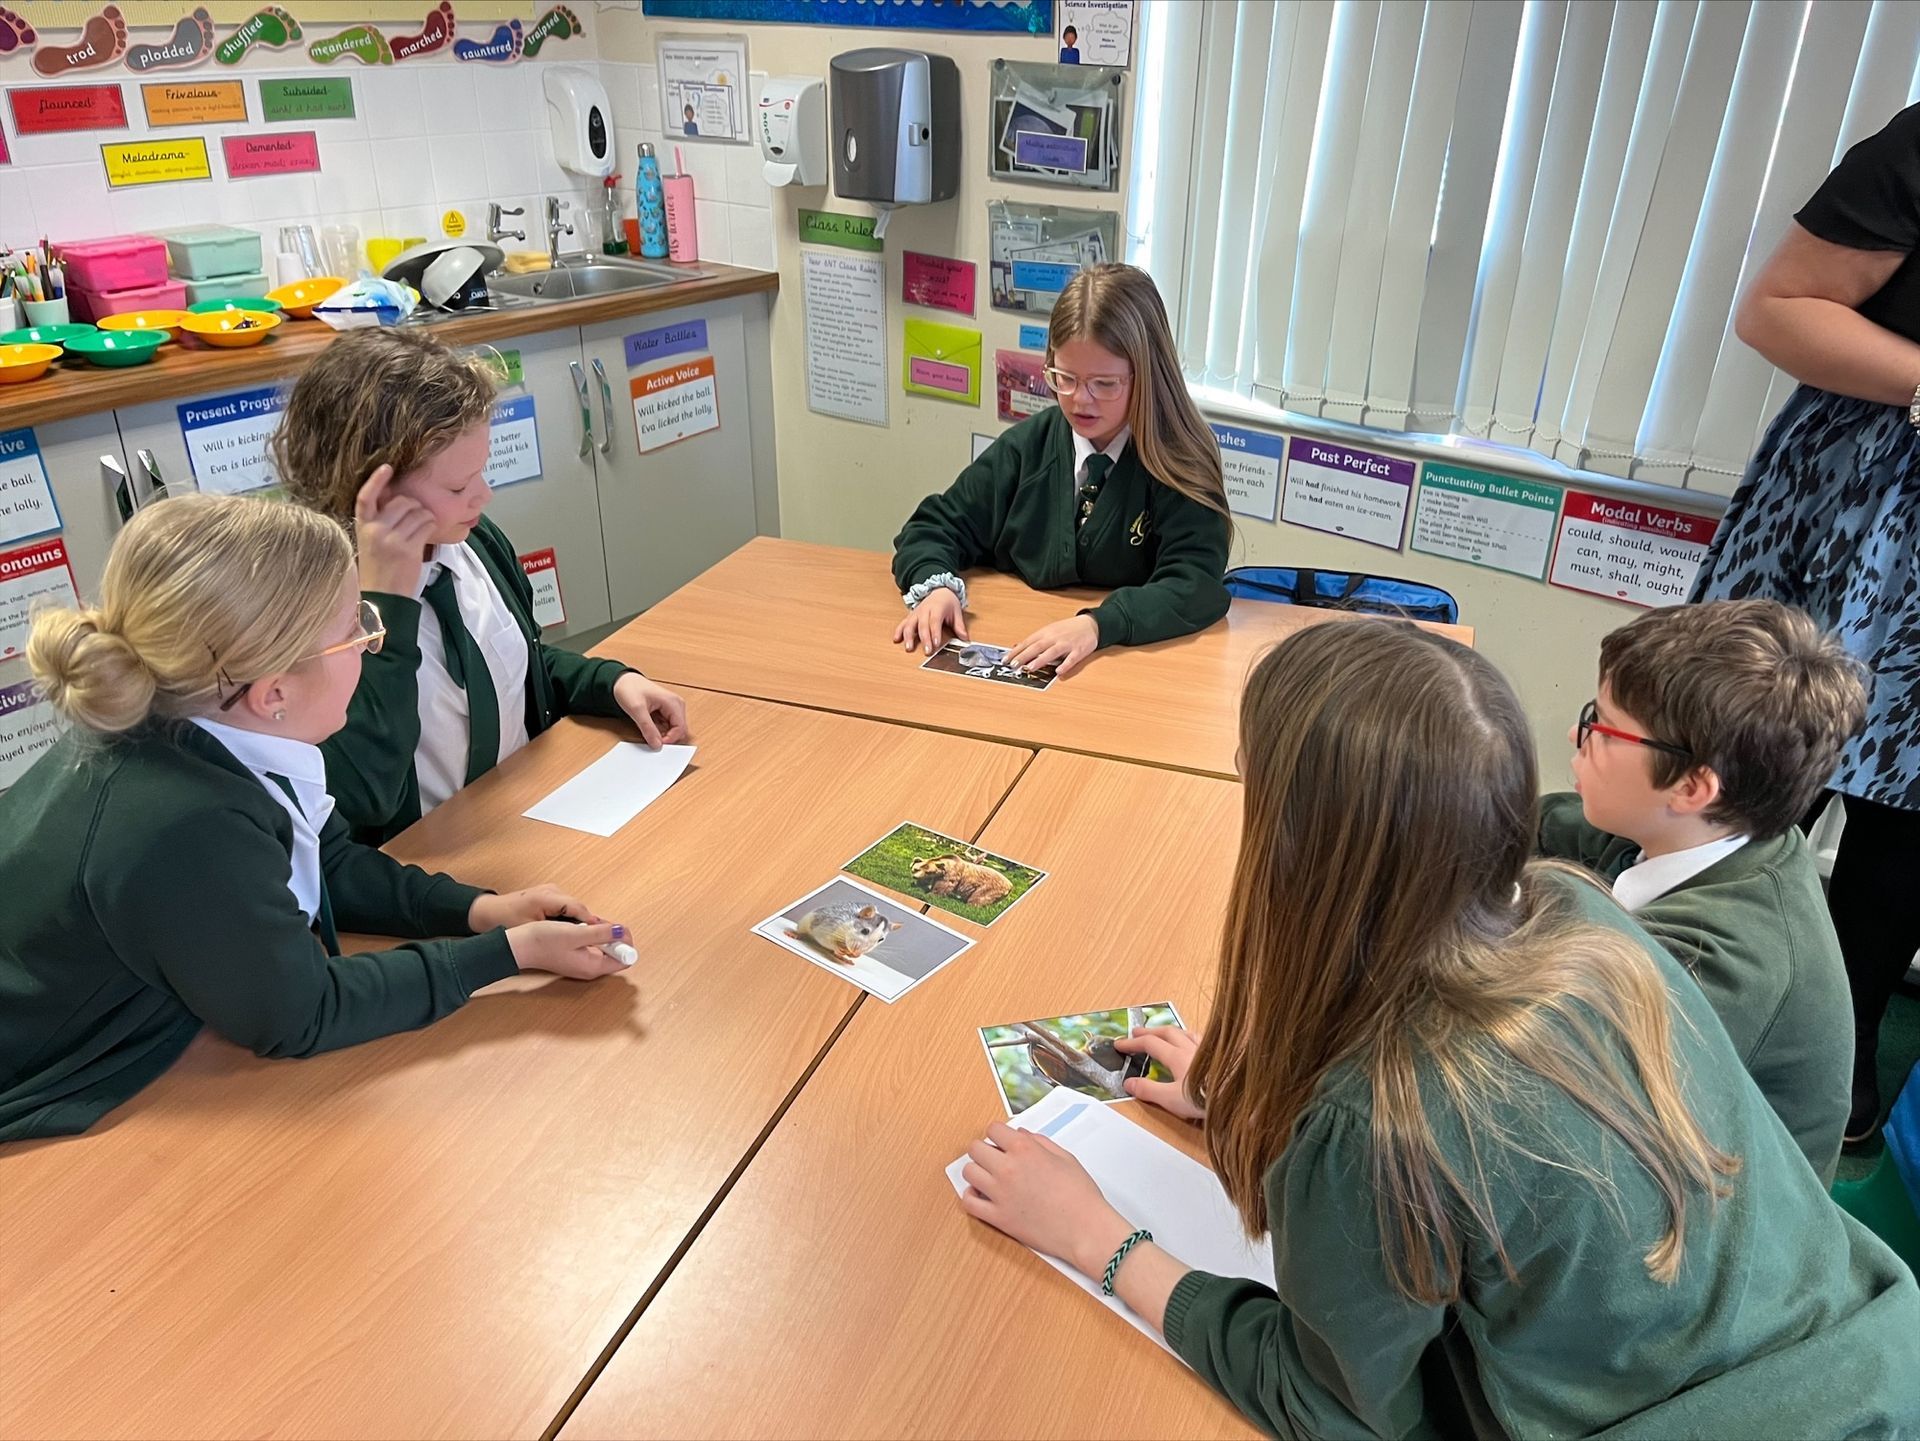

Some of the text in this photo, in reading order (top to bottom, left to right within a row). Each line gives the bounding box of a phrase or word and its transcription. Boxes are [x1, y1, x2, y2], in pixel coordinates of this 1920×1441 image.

[1065, 0, 1128, 12] Science Investigation
[222, 16, 264, 58] shuffled
[527, 13, 560, 46] traipsed
[310, 33, 372, 57] meandered
[400, 27, 443, 57] marched
[462, 41, 512, 60] sauntered
[66, 42, 96, 65] trod
[140, 42, 195, 67] plodded
[806, 215, 839, 232] Class
[633, 330, 697, 352] Water Bottles
[646, 367, 700, 391] Active Voice
[186, 394, 288, 423] Present Progre
[638, 386, 712, 418] Will kicked the ball.
[641, 424, 656, 434] Eva
[658, 413, 680, 429] licked
[681, 411, 693, 421] the
[203, 442, 224, 453] Will
[227, 438, 235, 449] is
[501, 432, 521, 443] better
[1215, 431, 1246, 447] shes
[494, 441, 529, 457] could kick
[210, 464, 228, 475] Eva
[231, 460, 239, 470] is
[1224, 461, 1237, 470] are
[1238, 462, 1265, 476] friends
[1311, 447, 1340, 464] Past
[1343, 454, 1390, 476] Perfect
[10, 473, 36, 488] ball.
[1223, 474, 1265, 488] nown each
[1426, 471, 1486, 493] Punctuating
[1489, 483, 1519, 498] Bullet
[1521, 490, 1554, 506] Points
[1227, 487, 1249, 498] years.
[1290, 476, 1402, 509] Will had finished his homework.
[14, 498, 43, 512] lolly.
[1295, 491, 1392, 521] Eva had eaten an ice-cream.
[1439, 508, 1460, 519] football
[1461, 514, 1475, 522] with
[1476, 516, 1489, 524] Will
[1419, 518, 1429, 526] The
[1443, 522, 1452, 532] for
[1453, 525, 1464, 533] this
[1591, 501, 1640, 523] Modal
[1647, 512, 1693, 534] Verbs
[1567, 527, 1701, 563] could, should, would
[523, 556, 552, 571] Phrase
[1577, 546, 1684, 580] can, may, might,
[536, 583, 553, 594] with
[1570, 562, 1685, 597] must, shall, ought
[534, 596, 556, 607] lollies
